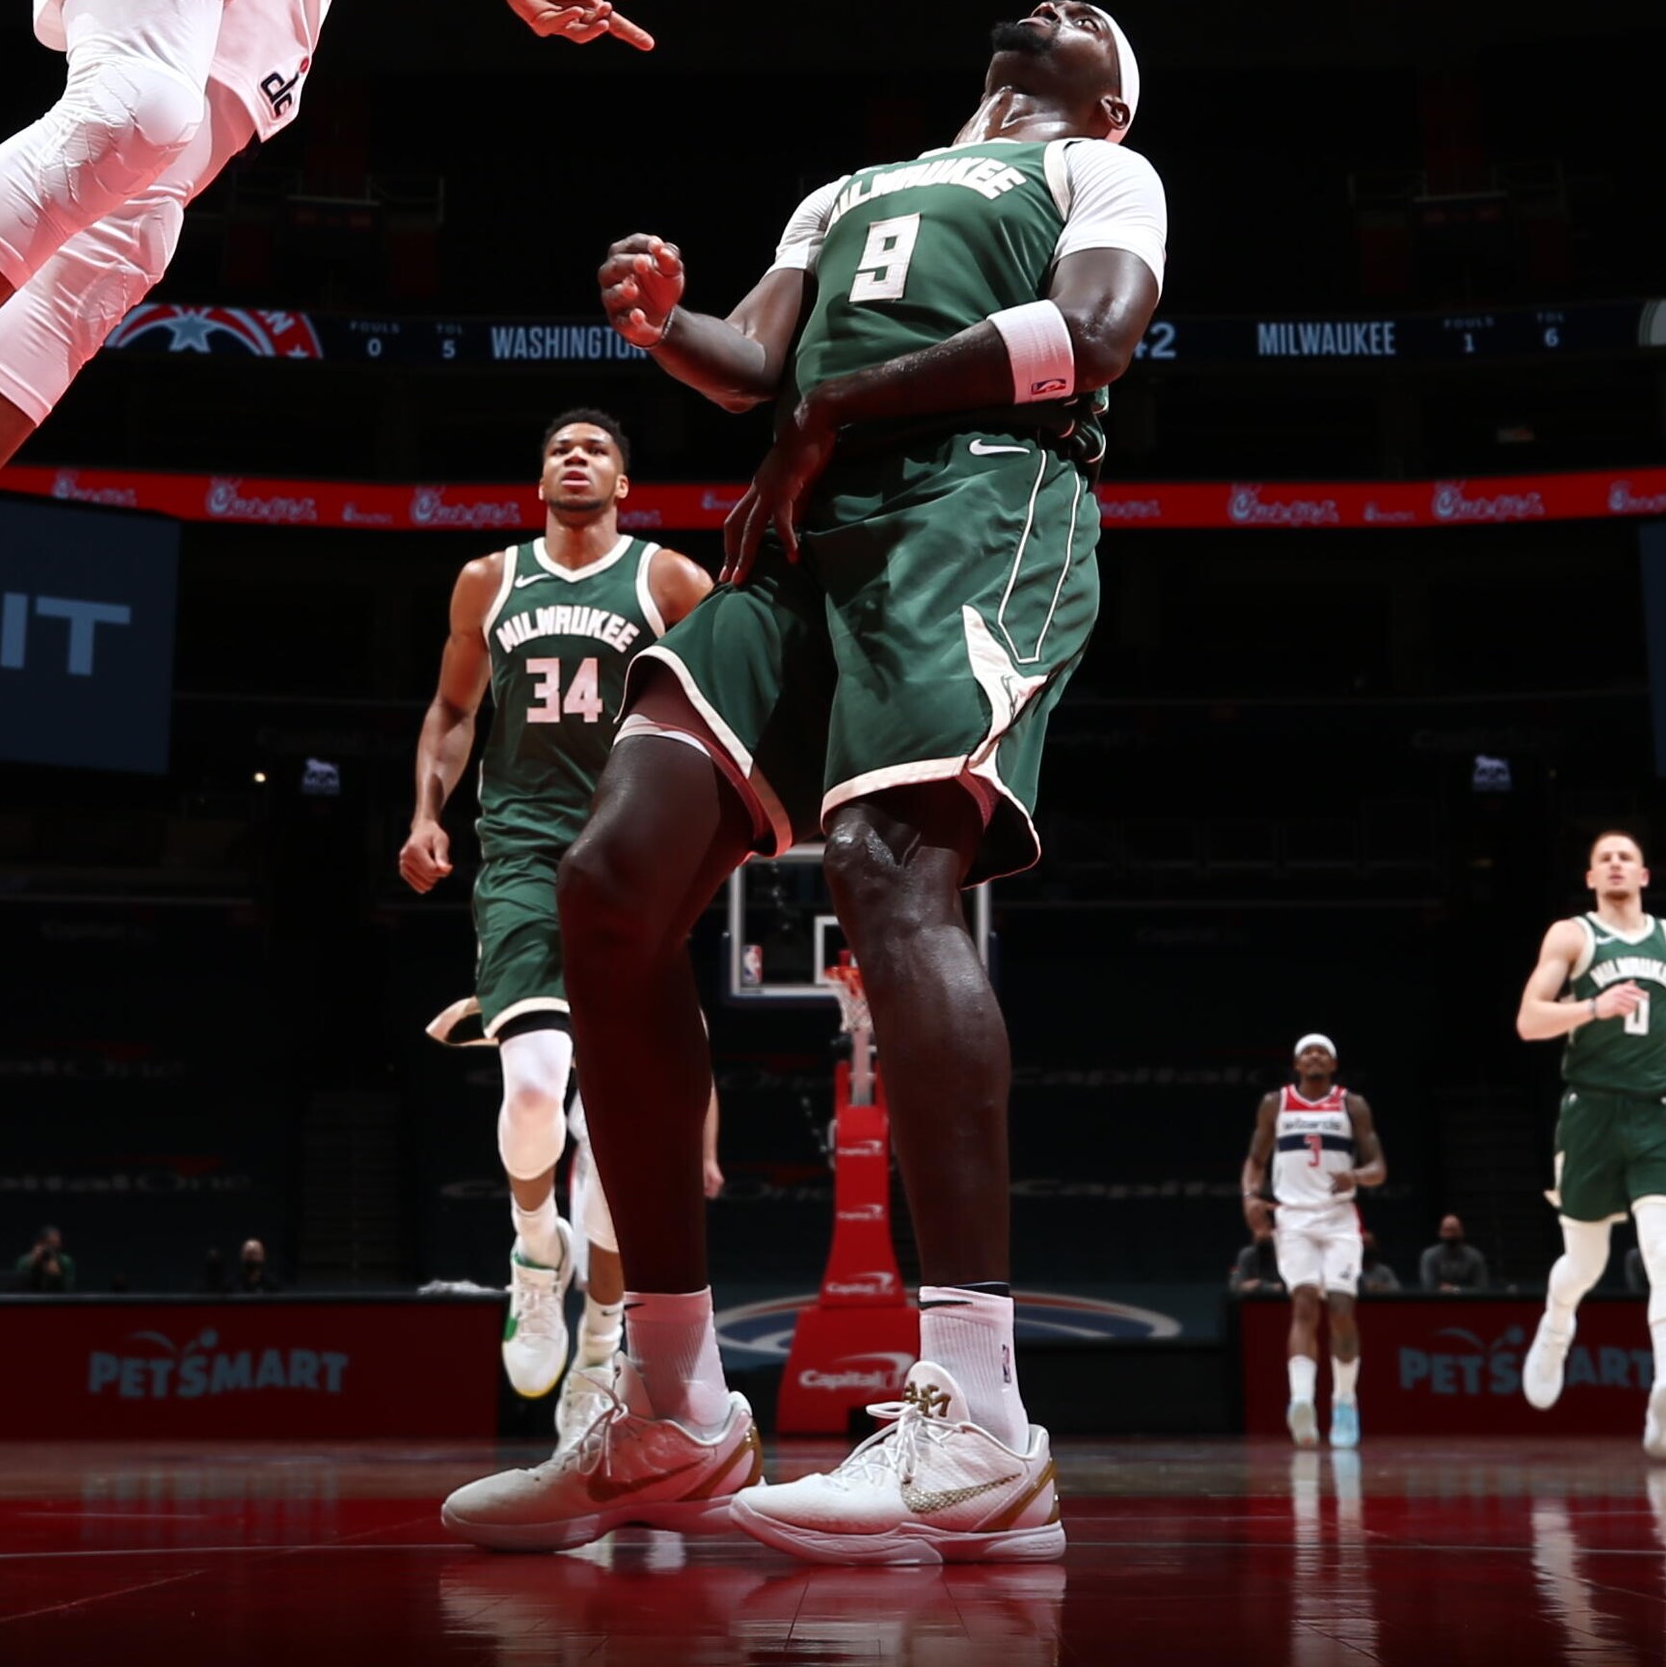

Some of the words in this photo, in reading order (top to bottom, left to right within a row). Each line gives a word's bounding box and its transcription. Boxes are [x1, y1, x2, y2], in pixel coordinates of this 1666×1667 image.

[848, 213, 921, 303] 9
[366, 338, 382, 358] 0
[442, 339, 457, 359] 5
[1256, 320, 1397, 357] MILWAUKEE
[1463, 333, 1475, 353] 1
[1544, 326, 1559, 348] 6
[495, 604, 641, 654] MILWAUKEE
[525, 656, 604, 724] 34
[86, 1347, 350, 1400] PETSMART
[1399, 1346, 1655, 1396] PETSART
